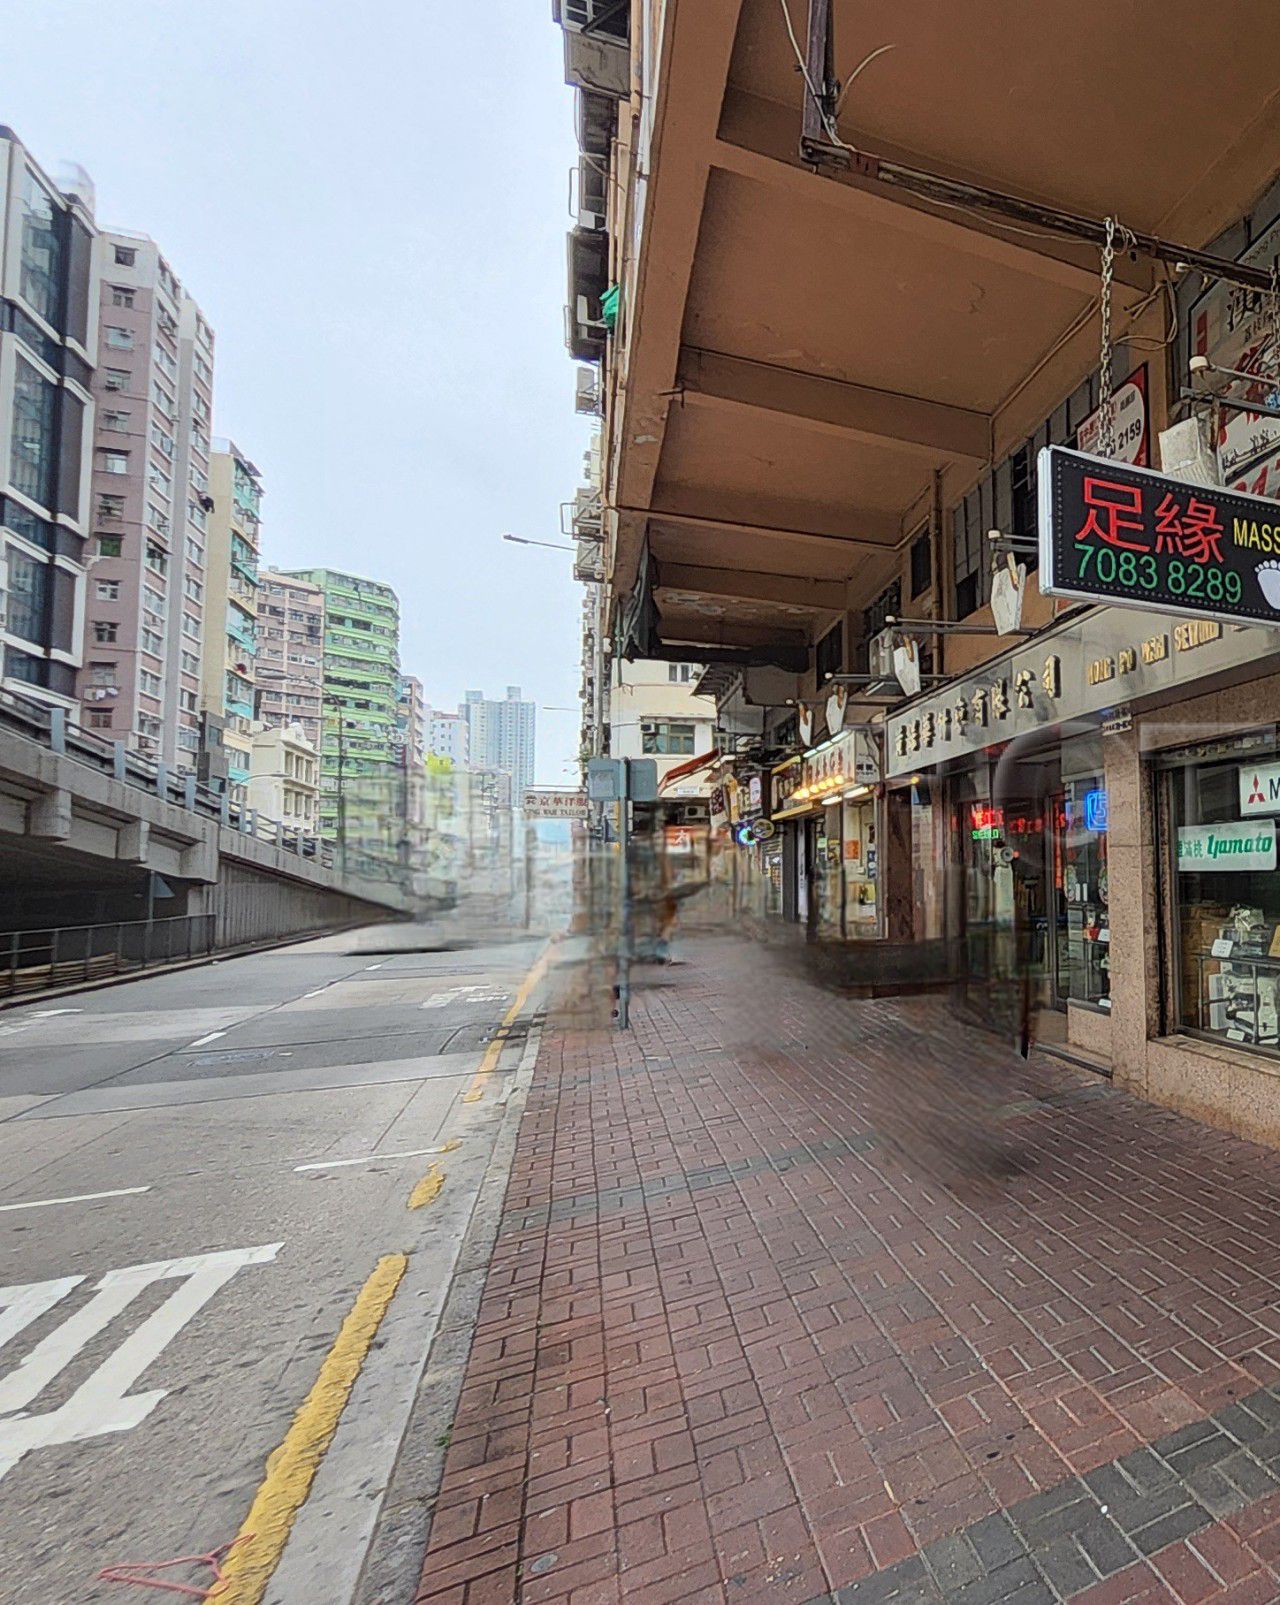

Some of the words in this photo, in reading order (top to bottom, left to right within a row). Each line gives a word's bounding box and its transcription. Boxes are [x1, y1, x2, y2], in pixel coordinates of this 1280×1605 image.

[1118, 418, 1142, 450] 2159
[1074, 476, 1224, 564] 足緣
[1074, 543, 1158, 590] 7083
[1167, 560, 1243, 604] 8289
